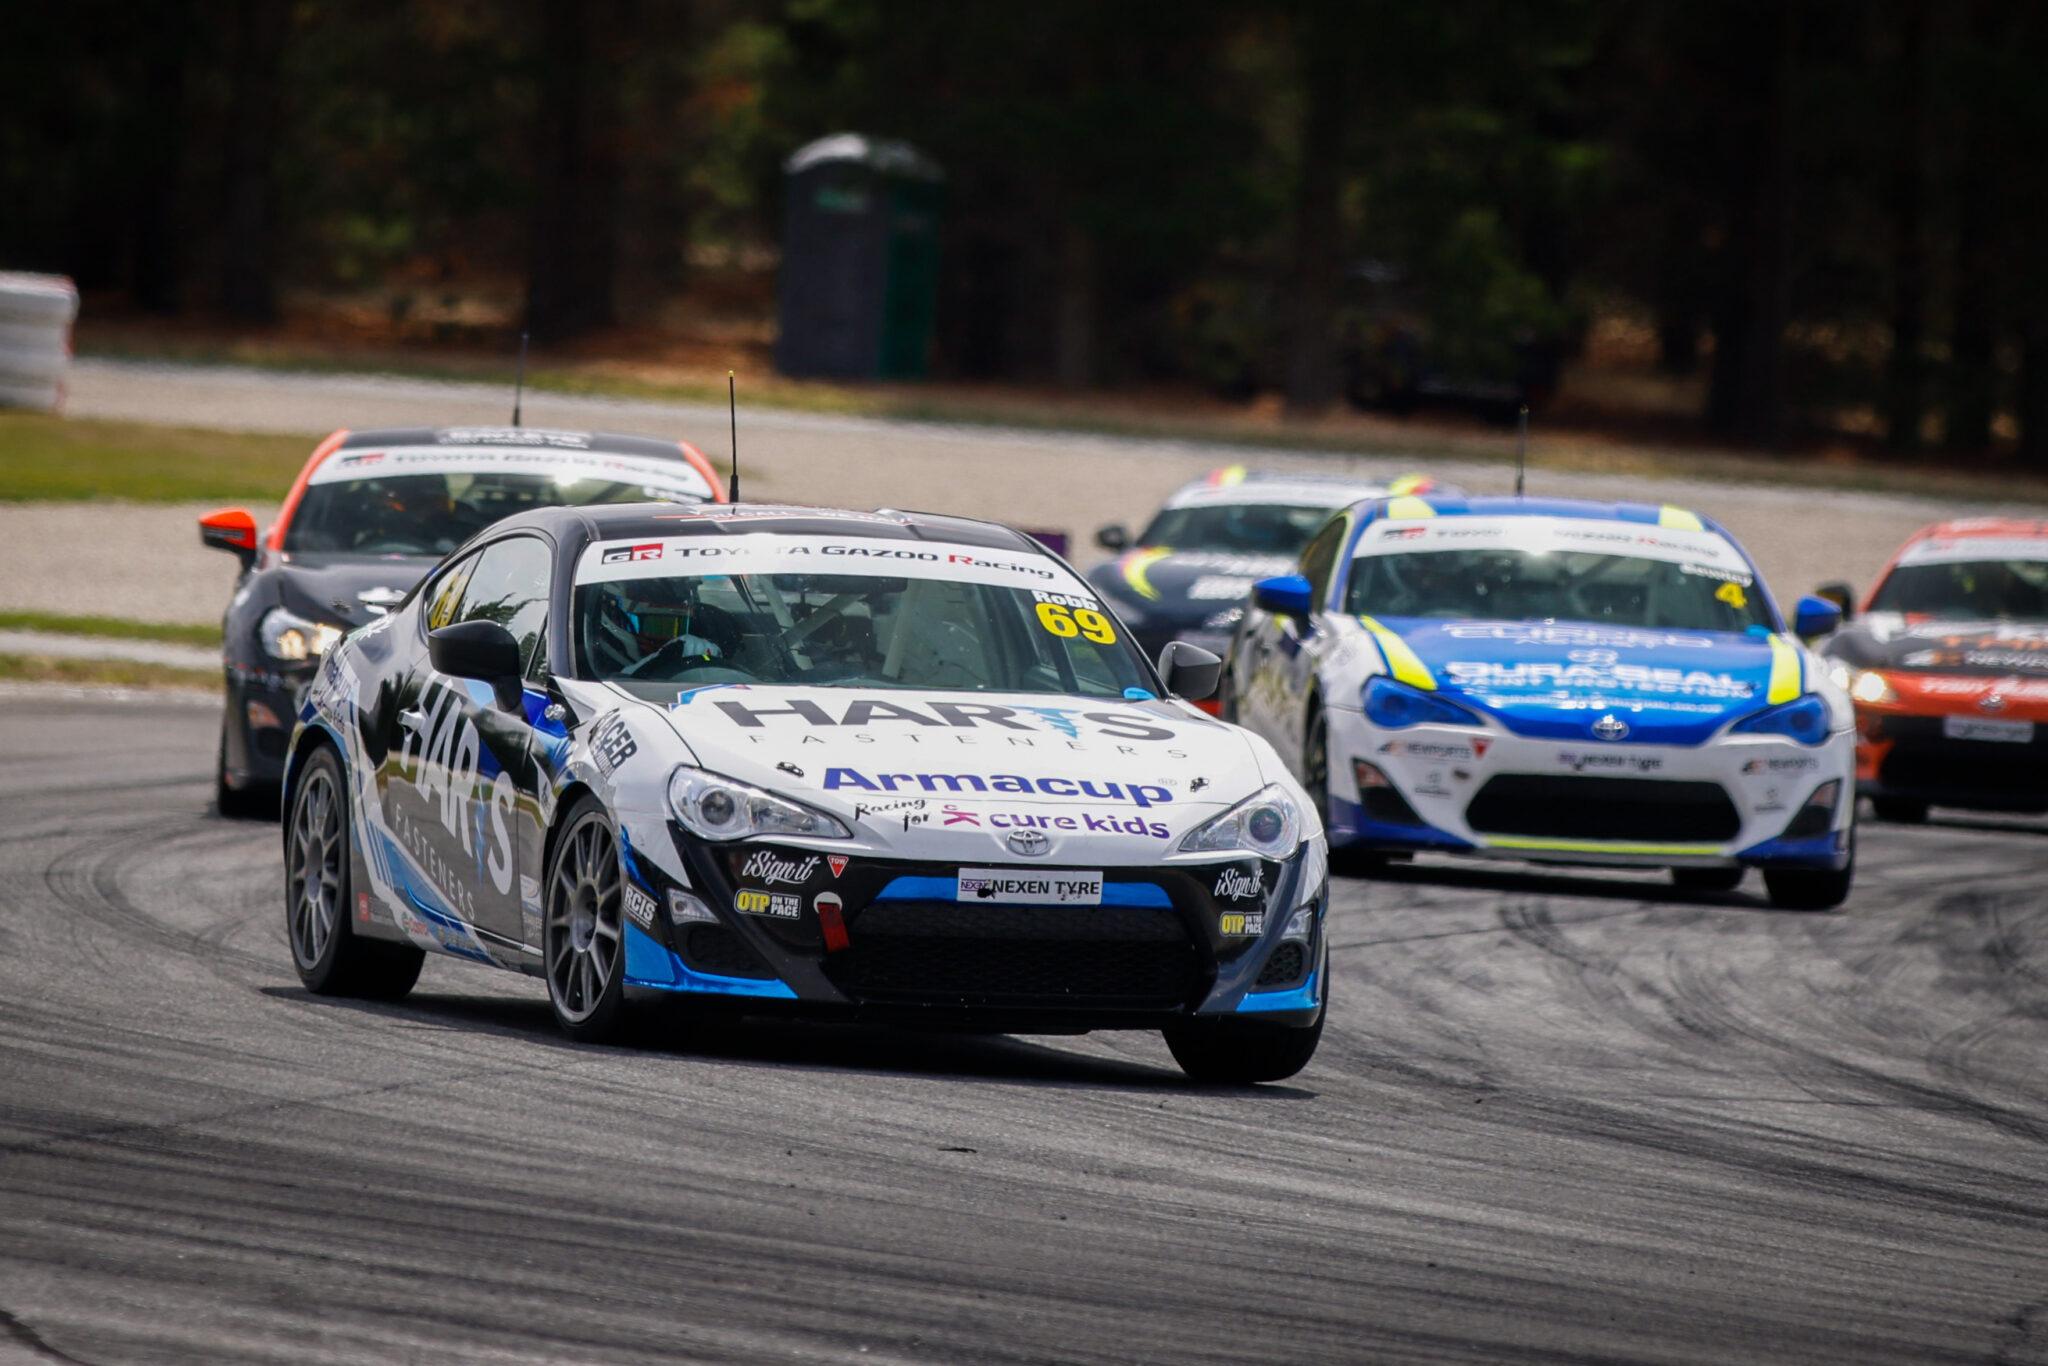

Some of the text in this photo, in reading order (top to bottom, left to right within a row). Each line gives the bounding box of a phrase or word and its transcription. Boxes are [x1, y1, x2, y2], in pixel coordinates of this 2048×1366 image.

[602, 546, 663, 565] GR
[820, 545, 939, 562] GAZOO
[947, 554, 1055, 580] Racing
[1031, 590, 1100, 612] Robb
[1714, 581, 1748, 609] 4
[1035, 602, 1117, 645] 69
[748, 733, 1188, 760] FASTENERS
[822, 767, 1174, 809] Armacup
[854, 798, 928, 821] Racing
[901, 810, 930, 833] for
[989, 812, 1171, 840] cure kids
[394, 803, 476, 922] FASTENERS
[992, 879, 1050, 894] NEXEN
[1055, 881, 1100, 896] TYRE
[625, 886, 656, 921] RCIS
[737, 891, 771, 913] OTP
[770, 905, 799, 918] PACE
[771, 895, 799, 907] ON THE
[1221, 914, 1245, 934] OTP
